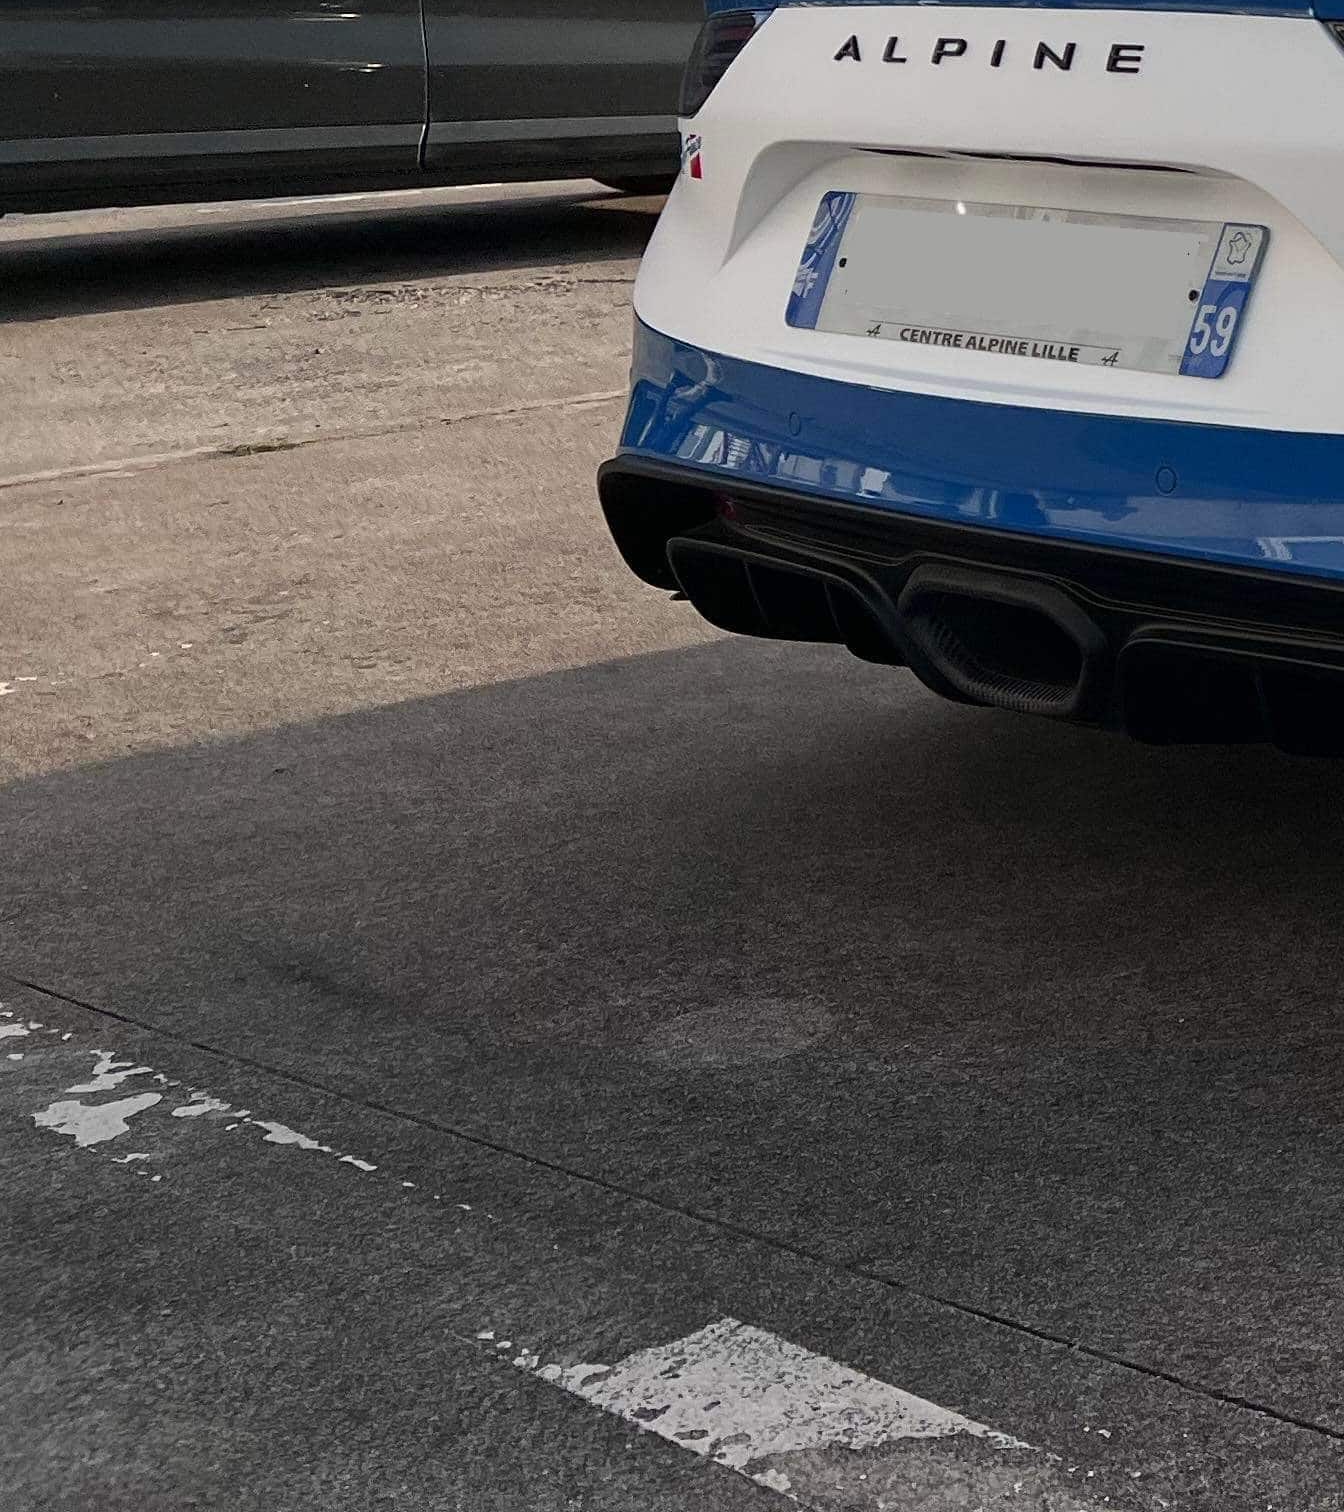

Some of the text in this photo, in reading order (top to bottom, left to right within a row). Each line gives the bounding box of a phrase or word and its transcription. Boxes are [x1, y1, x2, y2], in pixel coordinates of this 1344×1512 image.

[834, 35, 1146, 75] ALPINE
[900, 328, 963, 348] CENTRE
[965, 338, 1028, 357] ALPINE
[1031, 342, 1081, 363] LILLE
[1190, 304, 1237, 357] 59
